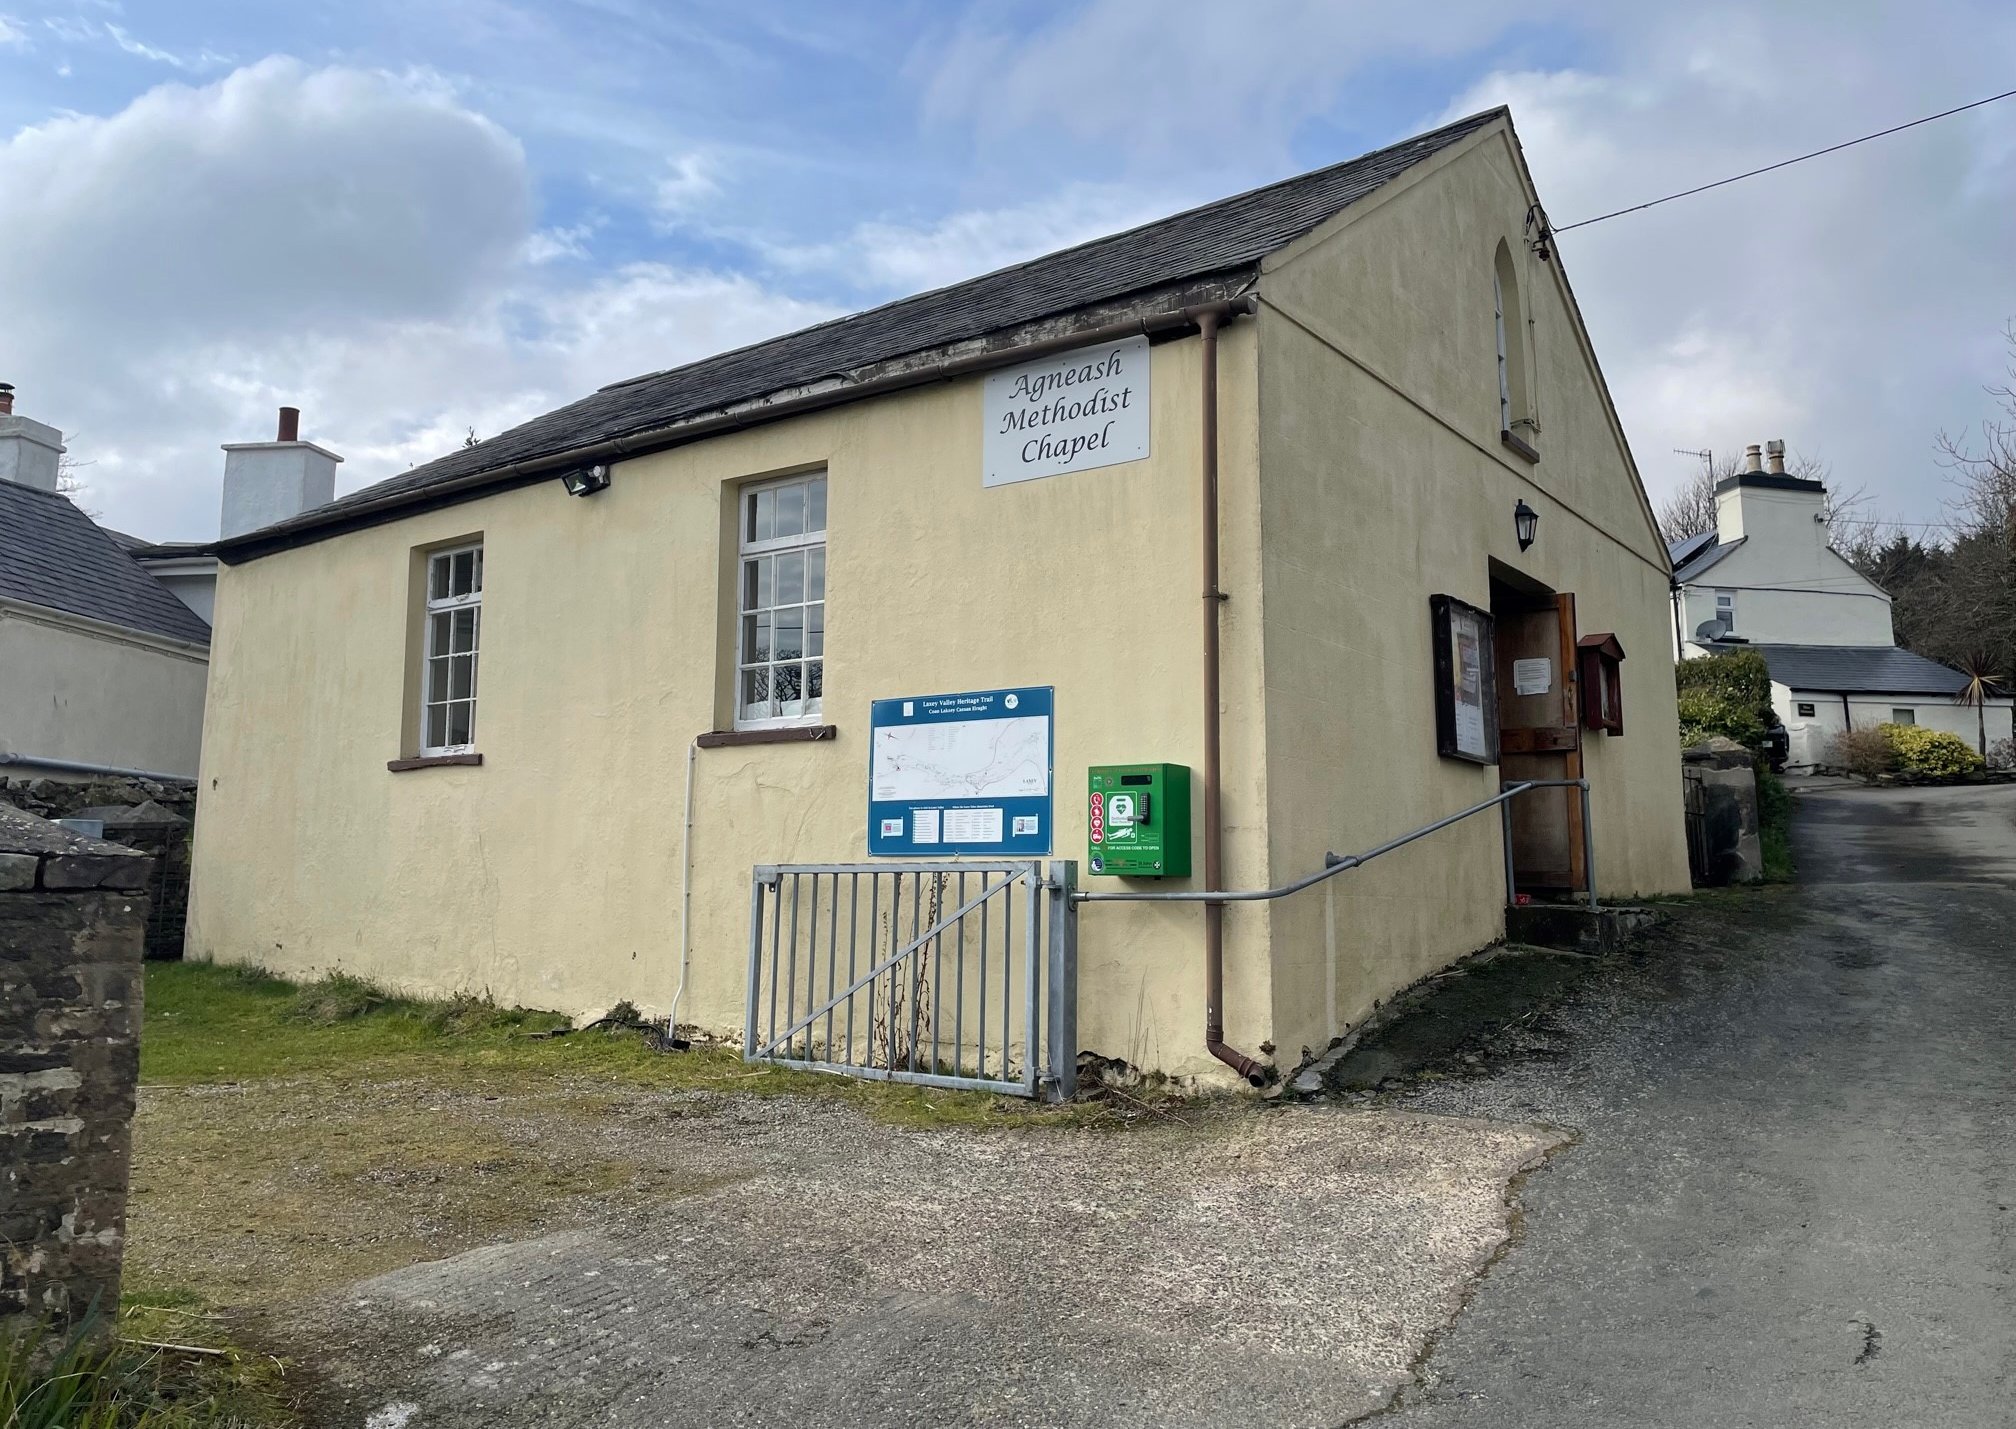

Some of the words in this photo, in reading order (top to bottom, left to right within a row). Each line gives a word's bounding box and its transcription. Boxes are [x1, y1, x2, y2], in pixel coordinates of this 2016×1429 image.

[1009, 350, 1123, 402] Agneash
[1000, 387, 1132, 434] Methodist
[1021, 421, 1116, 464] Chapel
